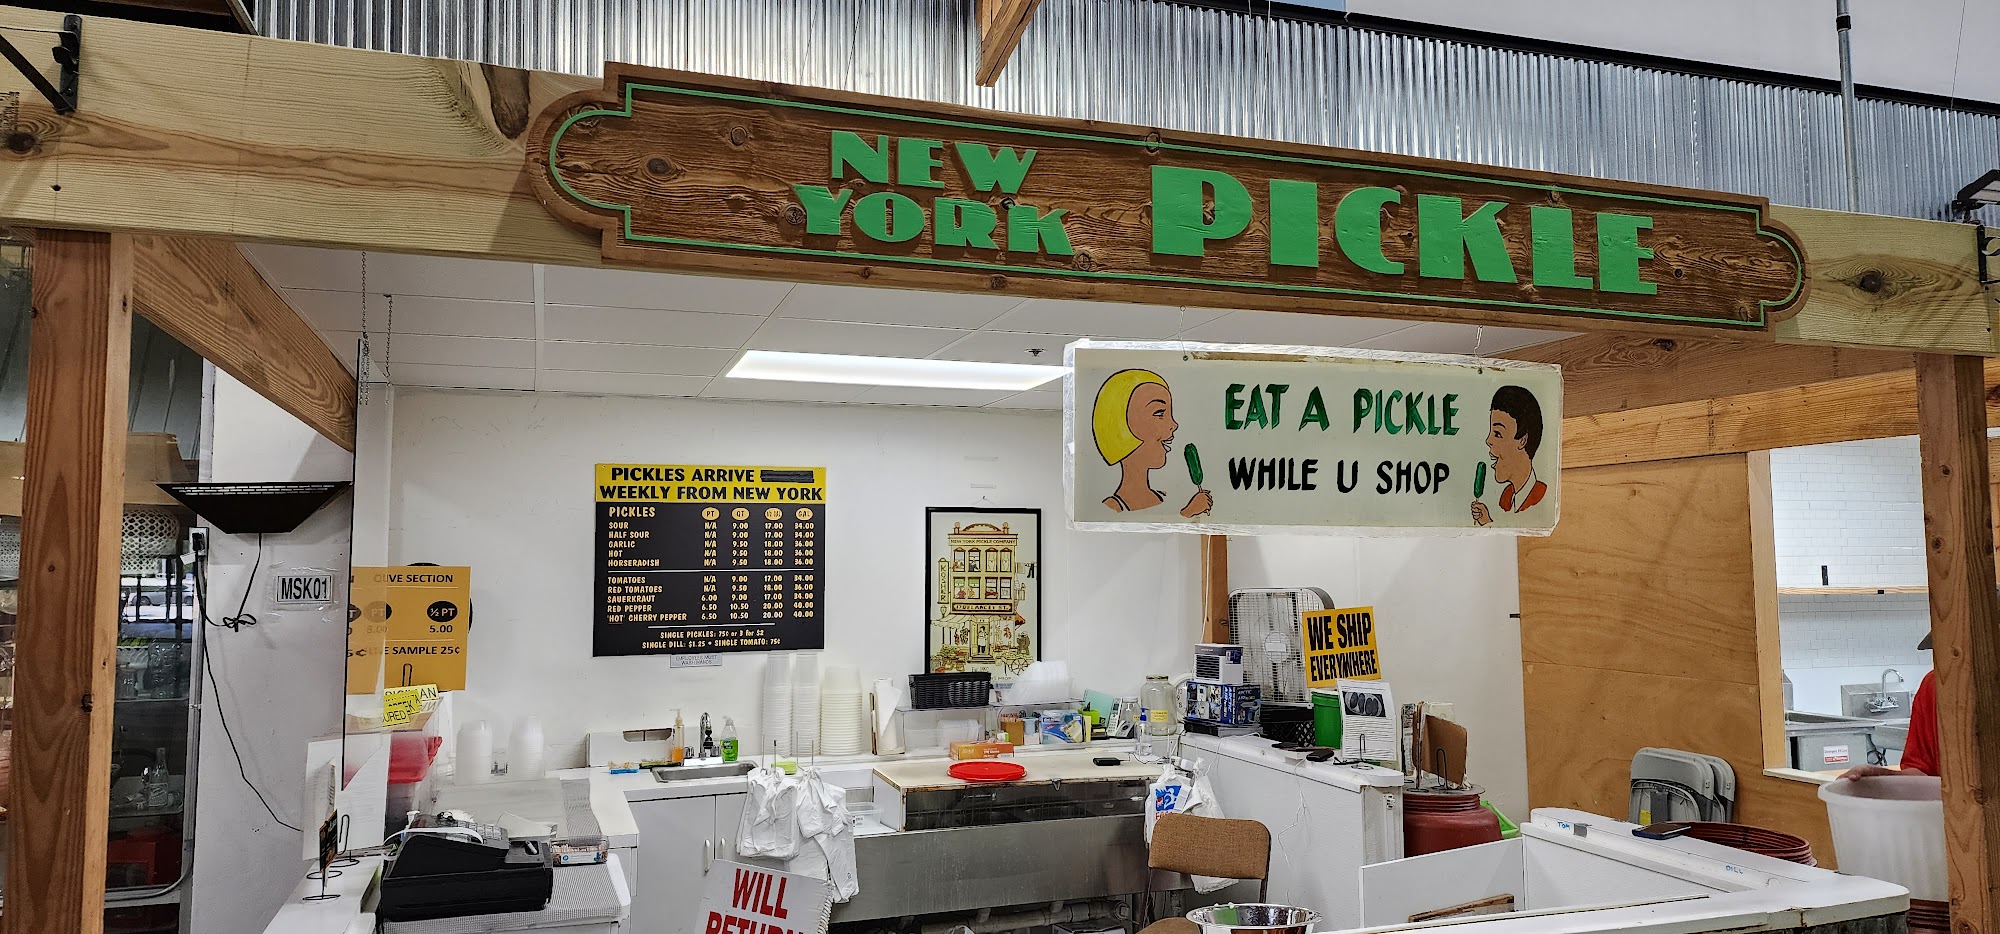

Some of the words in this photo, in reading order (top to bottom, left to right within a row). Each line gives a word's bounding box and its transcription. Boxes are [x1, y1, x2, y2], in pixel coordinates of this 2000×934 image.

[831, 130, 1037, 194] NEW
[793, 184, 1074, 256] YORK
[1151, 165, 1657, 295] PICKLE
[1225, 384, 1290, 430] EAT
[1298, 386, 1330, 432] A
[1353, 388, 1460, 436] PICKLE
[612, 468, 684, 481] PICKLES
[692, 469, 754, 482] ARRIVE
[1228, 456, 1318, 491] WHILE
[1337, 460, 1359, 493] U
[1376, 462, 1450, 494] SHOP
[600, 486, 670, 499] WEEKLY
[678, 487, 726, 499] FROM
[734, 487, 770, 499] NEW
[777, 488, 822, 500] YORK
[609, 507, 655, 517] PICKLES
[374, 574, 402, 582] OLIVE
[406, 574, 453, 582] SECTION
[281, 578, 327, 599] MSK01
[608, 595, 655, 603] SAUERKRAUT
[442, 608, 454, 616] PT
[429, 625, 453, 633] 5.00
[1308, 615, 1334, 651] WE
[1336, 612, 1372, 648] SHIP
[392, 646, 438, 654] SAMPLE
[440, 646, 460, 654] 25¢
[1310, 650, 1378, 682] EVERYWHERE
[1558, 822, 1570, 830] TOM
[1726, 866, 1743, 874] DILL
[732, 868, 788, 919] WILL
[706, 912, 802, 934] RET
